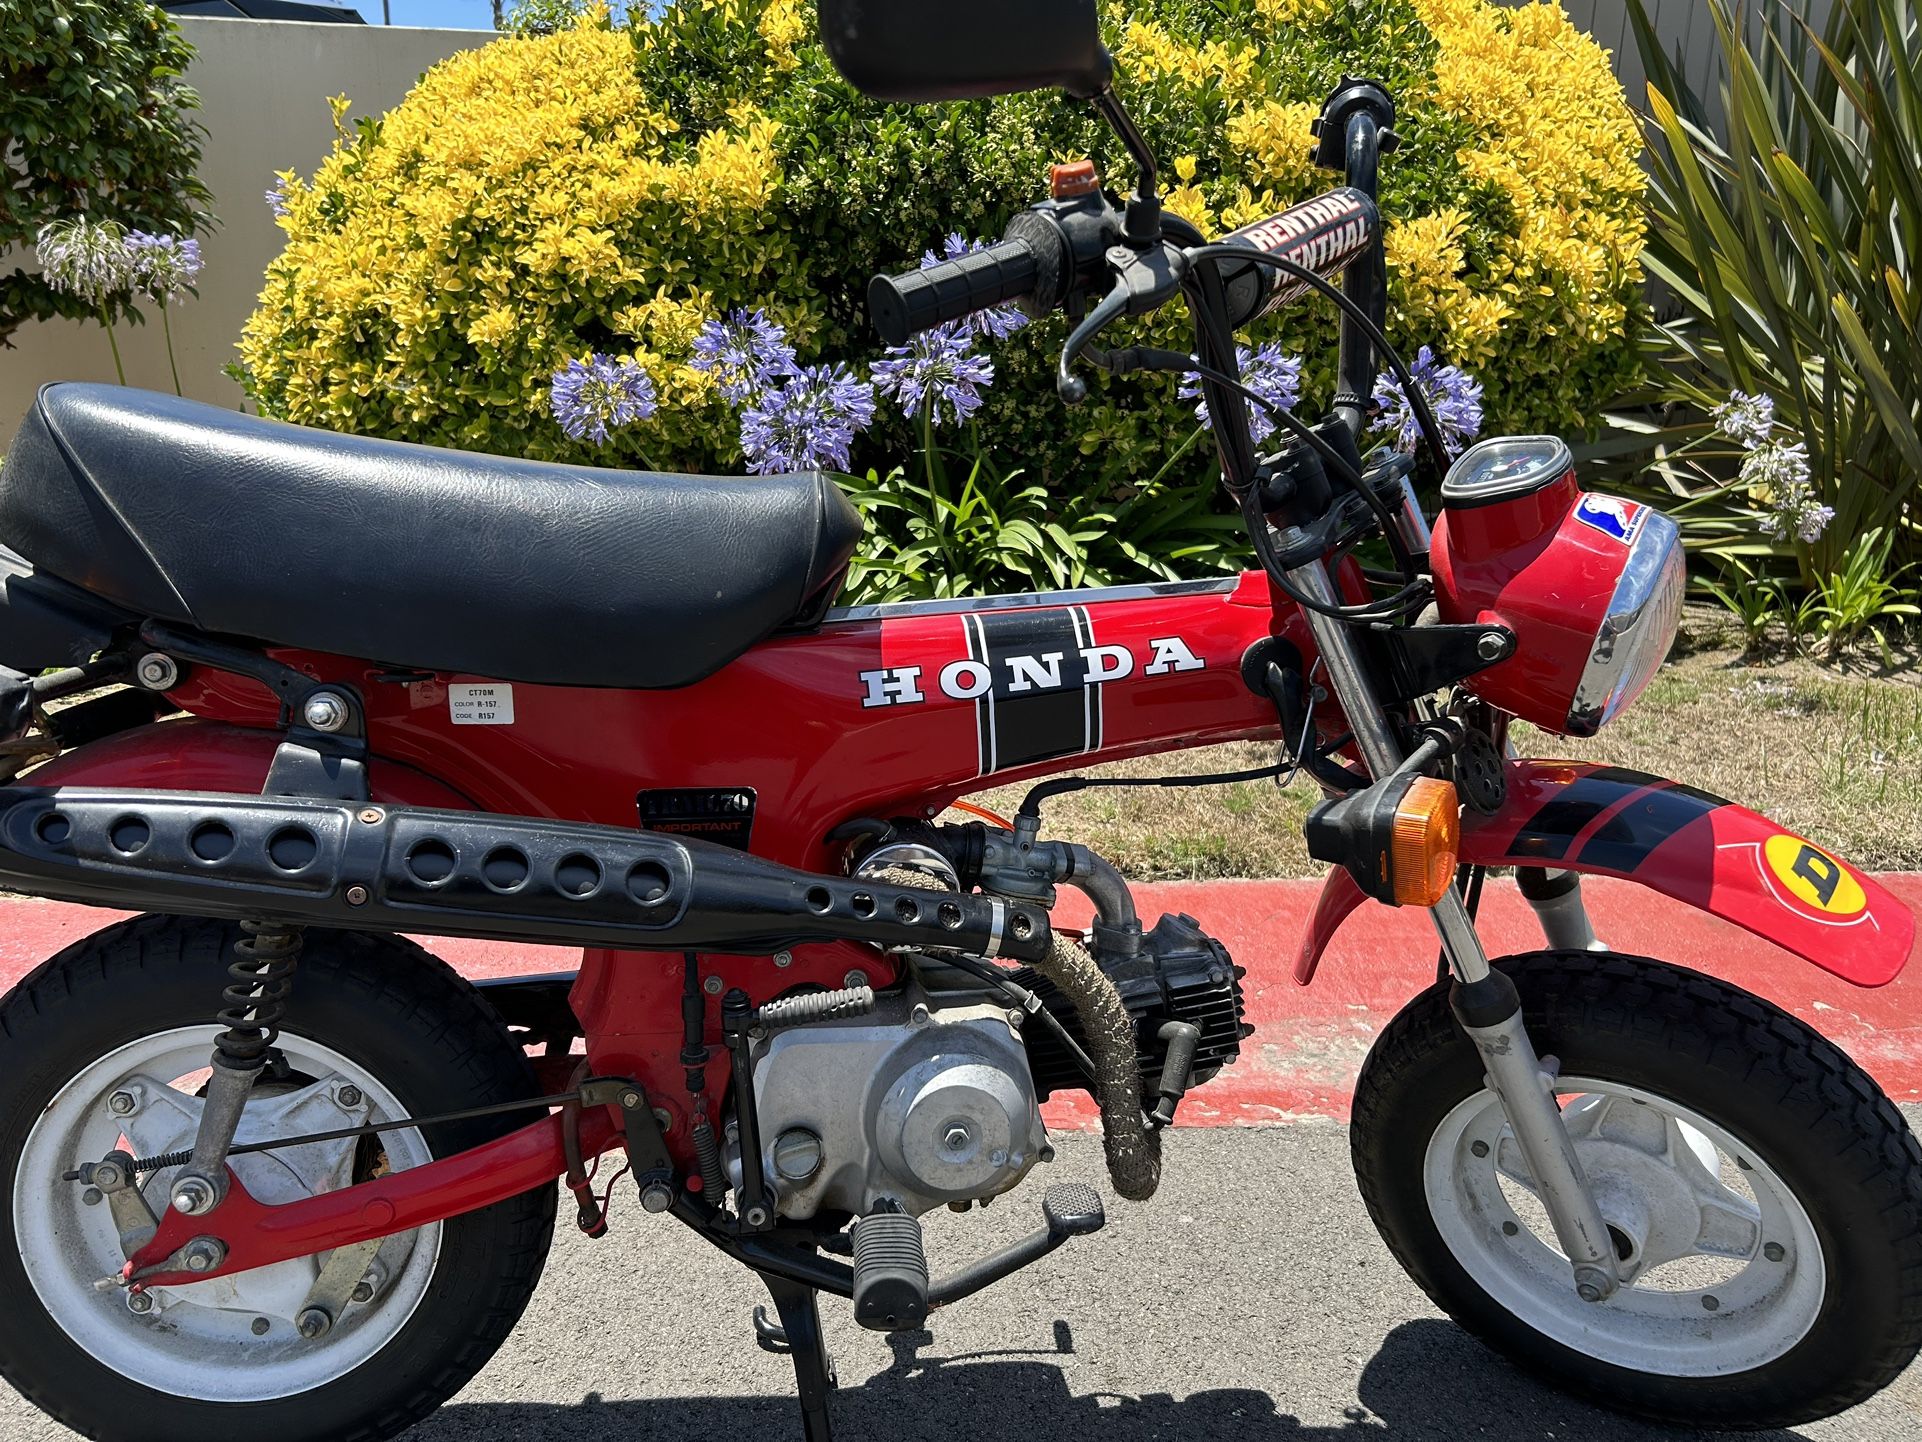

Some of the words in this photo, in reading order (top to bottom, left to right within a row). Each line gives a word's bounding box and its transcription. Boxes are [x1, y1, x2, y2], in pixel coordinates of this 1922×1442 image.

[1243, 193, 1361, 252] RENTHAL
[859, 636, 1206, 708] HONDA
[468, 689, 494, 697] CT70M
[477, 700, 497, 708] R-157
[478, 712, 495, 720] R157
[653, 821, 742, 832] IMPORTANT
[1791, 844, 1841, 907] D
